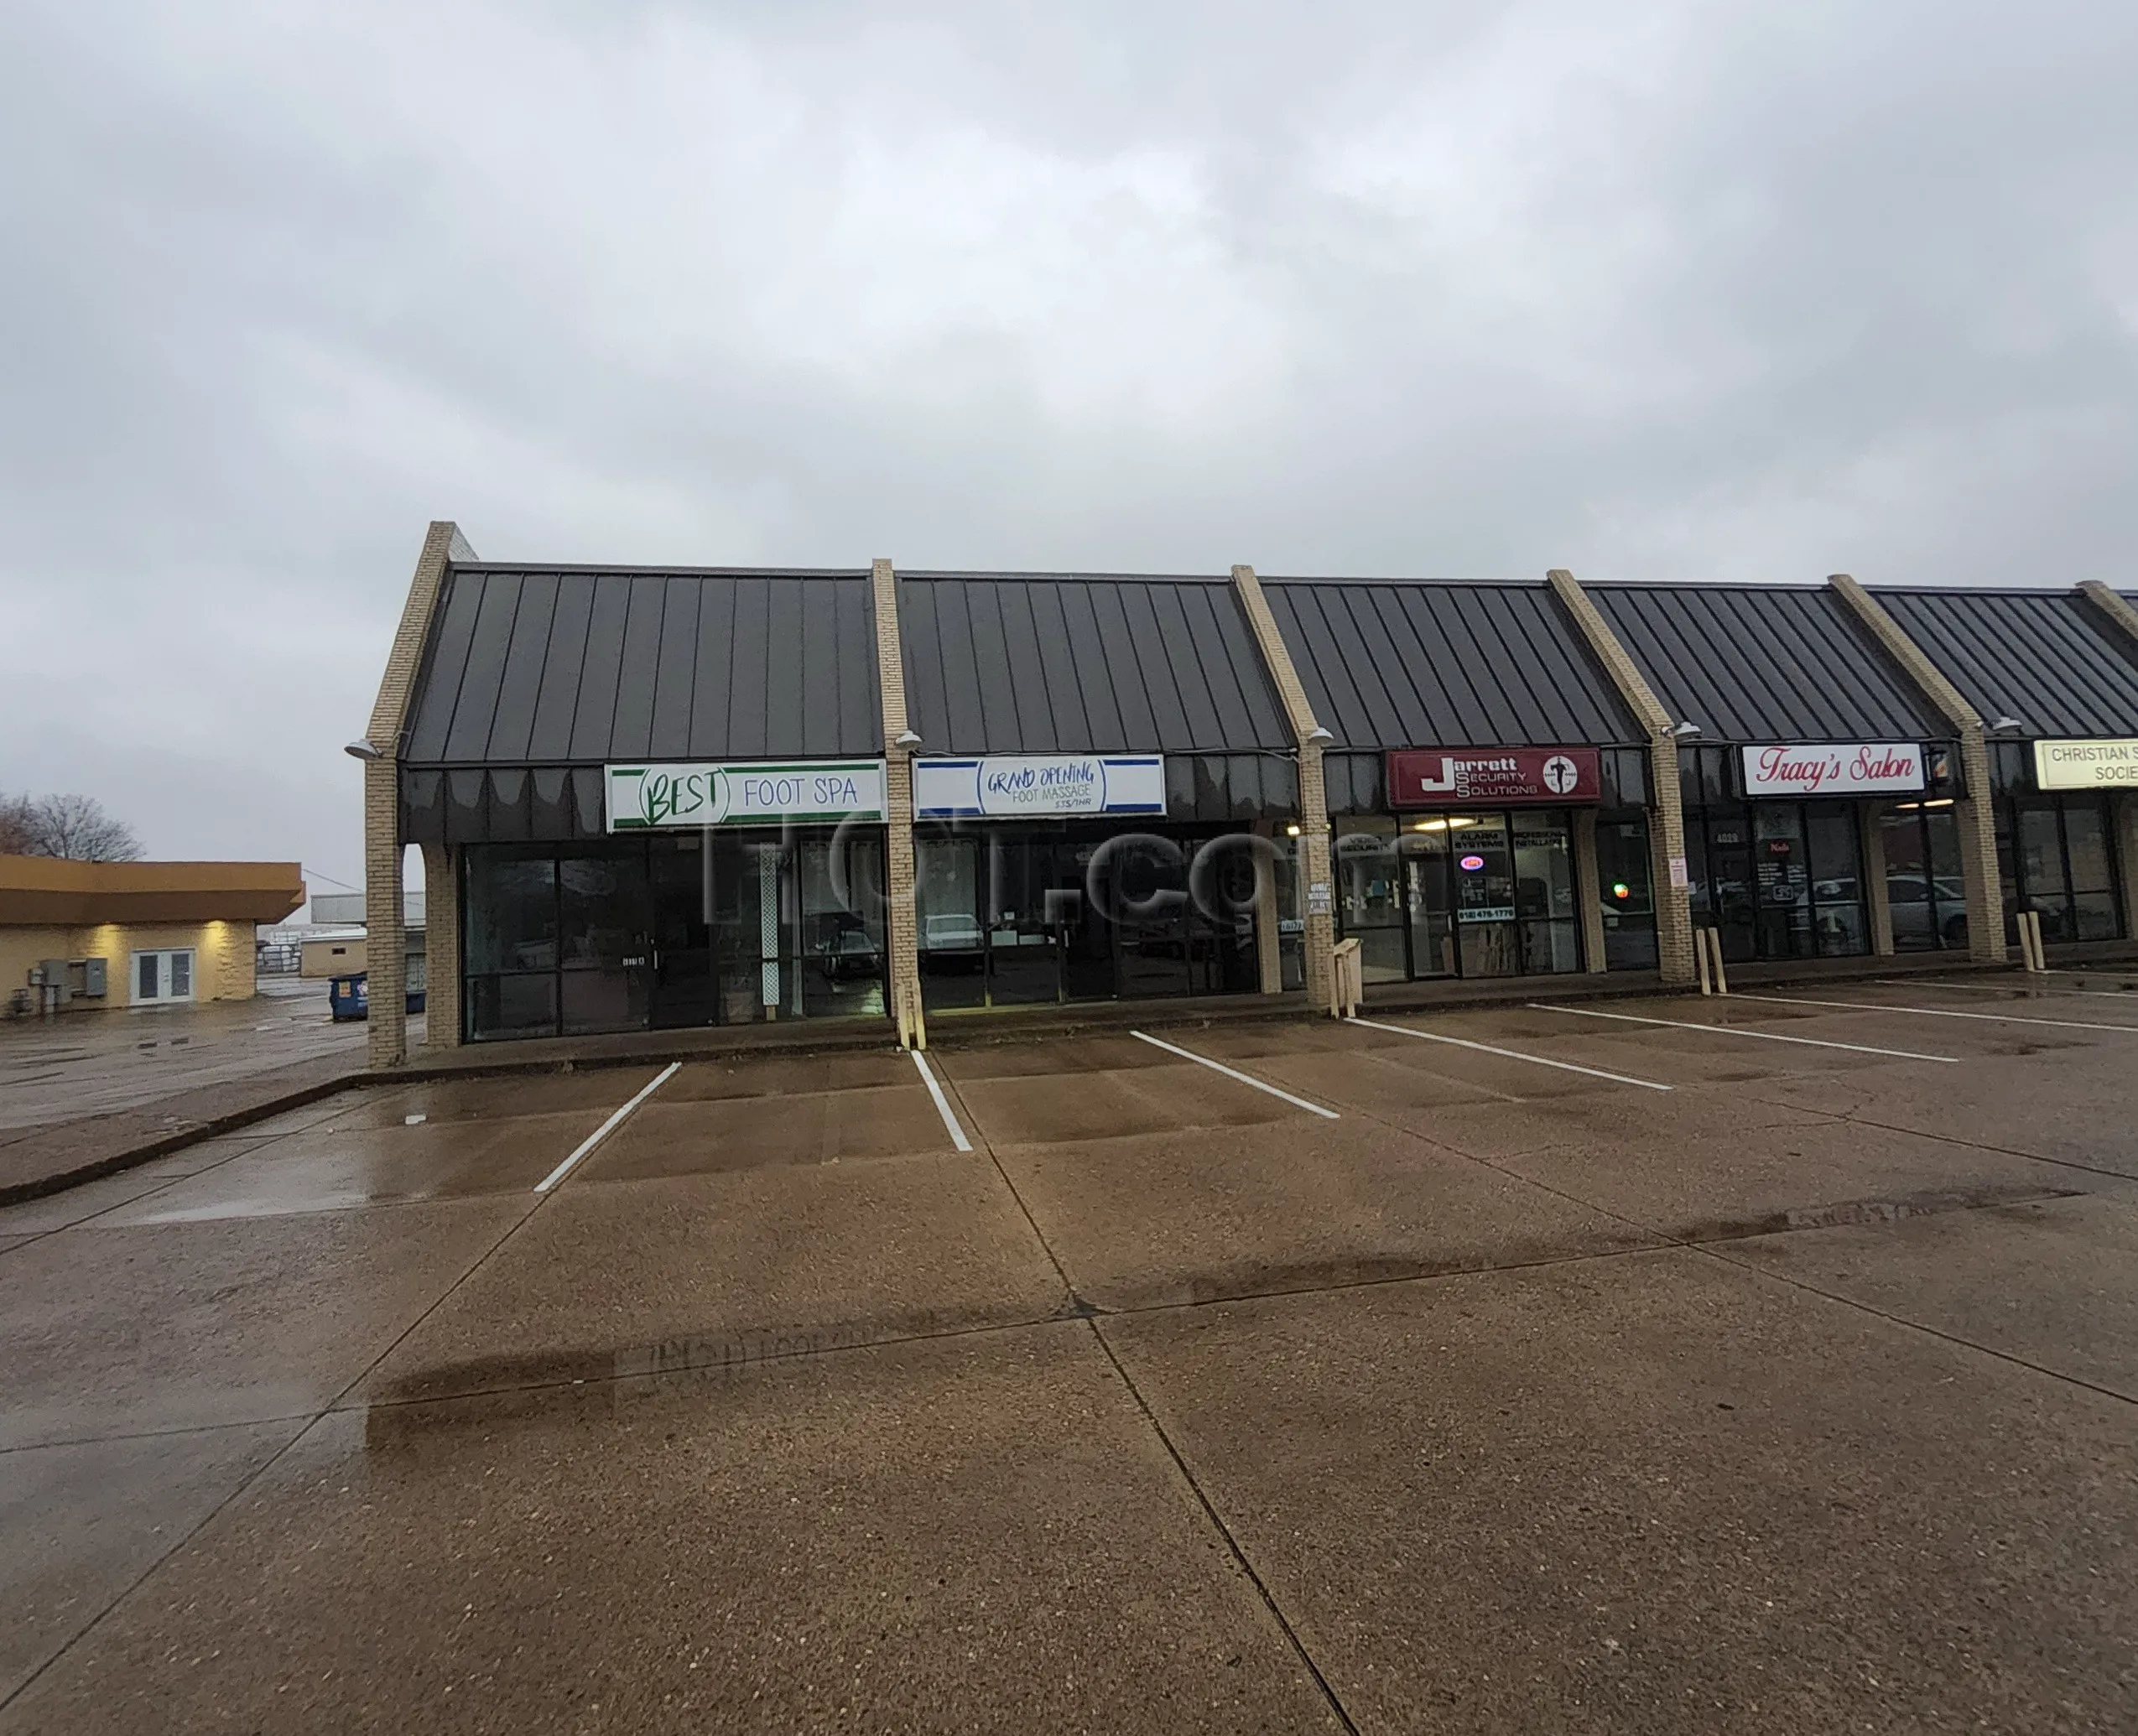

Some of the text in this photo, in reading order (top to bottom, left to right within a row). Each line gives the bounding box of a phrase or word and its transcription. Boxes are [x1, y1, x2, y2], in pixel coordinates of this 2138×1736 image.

[2052, 746, 2130, 761] CHRISTIAN
[987, 761, 1094, 795] GRAND OPENING
[1420, 757, 1517, 792] Jarrett
[1455, 772, 1527, 785] SECURITY
[1756, 746, 1916, 792] Tracy's Salon
[647, 767, 858, 825] BEST FOOT SPA
[1012, 783, 1090, 803] FOOT MASSAGE
[1456, 784, 1538, 798] SOLUTIONS
[1454, 840, 1504, 849] SYSTEMS
